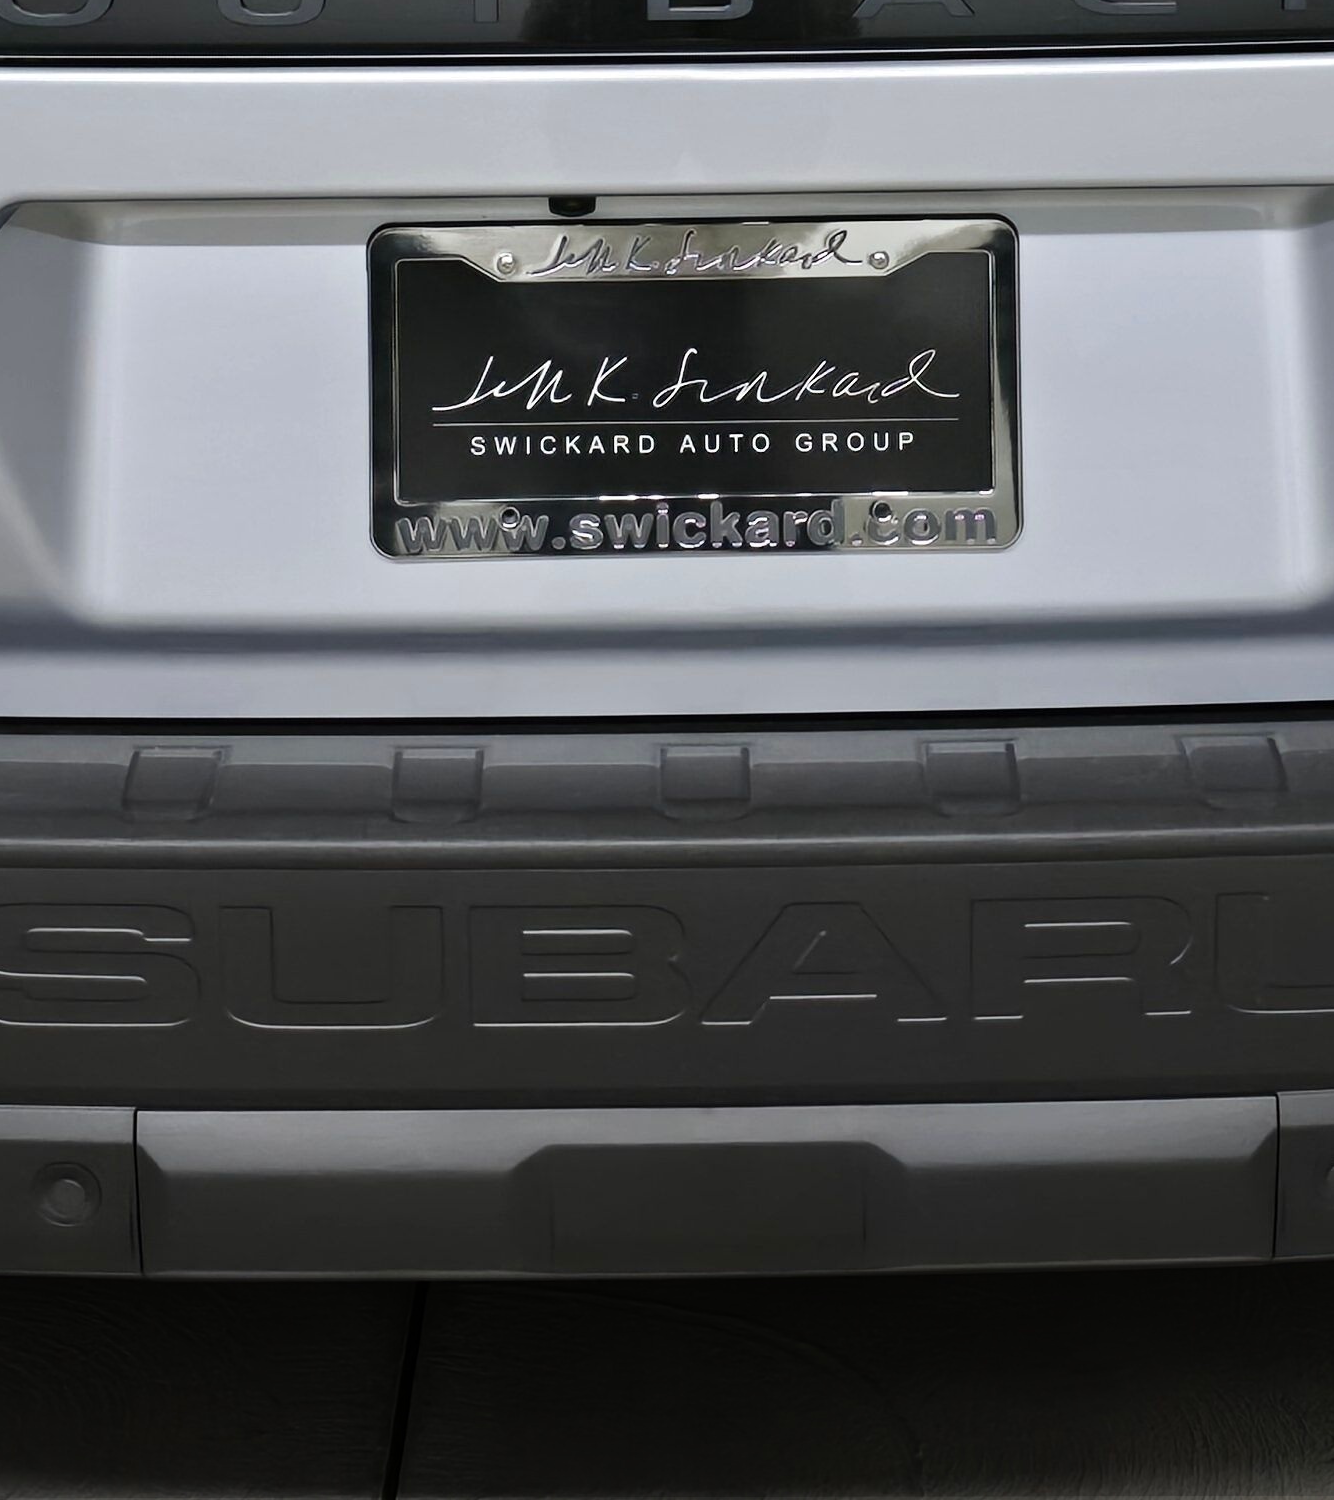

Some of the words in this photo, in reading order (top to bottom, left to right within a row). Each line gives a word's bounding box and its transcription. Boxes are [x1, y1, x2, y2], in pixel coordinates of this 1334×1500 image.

[469, 433, 657, 457] SWICKARD
[679, 432, 772, 455] AUTO
[794, 431, 916, 453] GROUP
[396, 500, 997, 552] www.swickard.com
